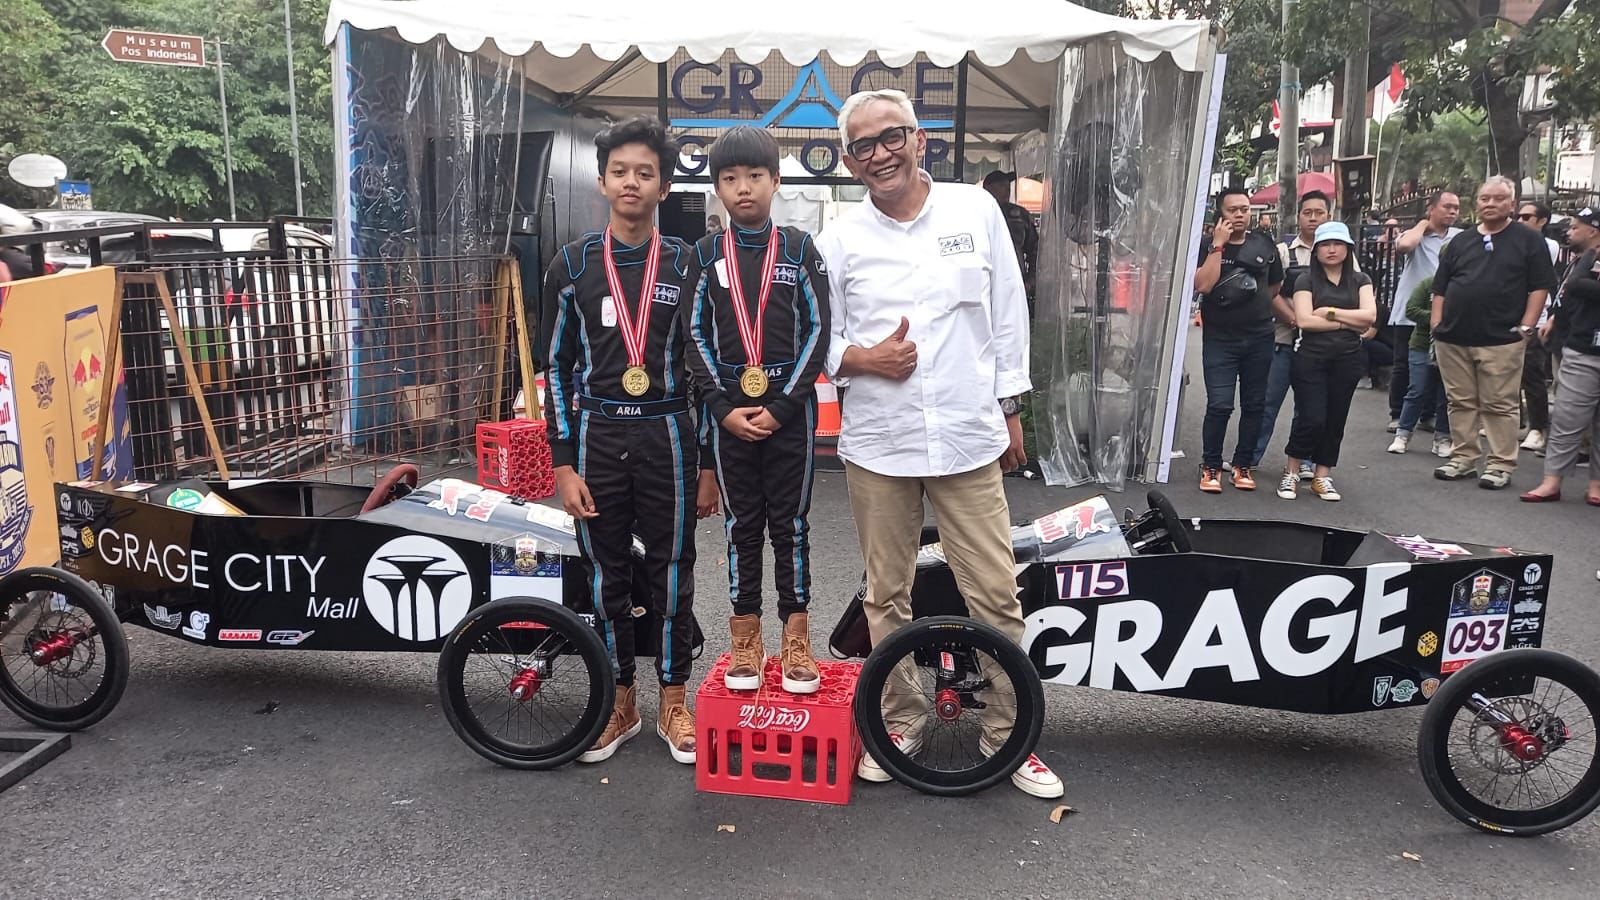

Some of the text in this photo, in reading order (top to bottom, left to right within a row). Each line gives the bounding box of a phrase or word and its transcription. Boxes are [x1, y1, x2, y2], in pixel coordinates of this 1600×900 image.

[121, 46, 197, 61] Pos Indonesia
[126, 35, 191, 49] Museum
[675, 135, 948, 176] GOP
[616, 406, 642, 416] ARIA
[1037, 514, 1068, 542] Bull
[98, 527, 326, 593] GRAGE CITY
[1056, 562, 1126, 599] 115
[306, 597, 359, 619] Mall
[1022, 562, 1412, 692] GRAGE
[1449, 619, 1504, 654] 093
[737, 704, 811, 732] Coca-Cola
